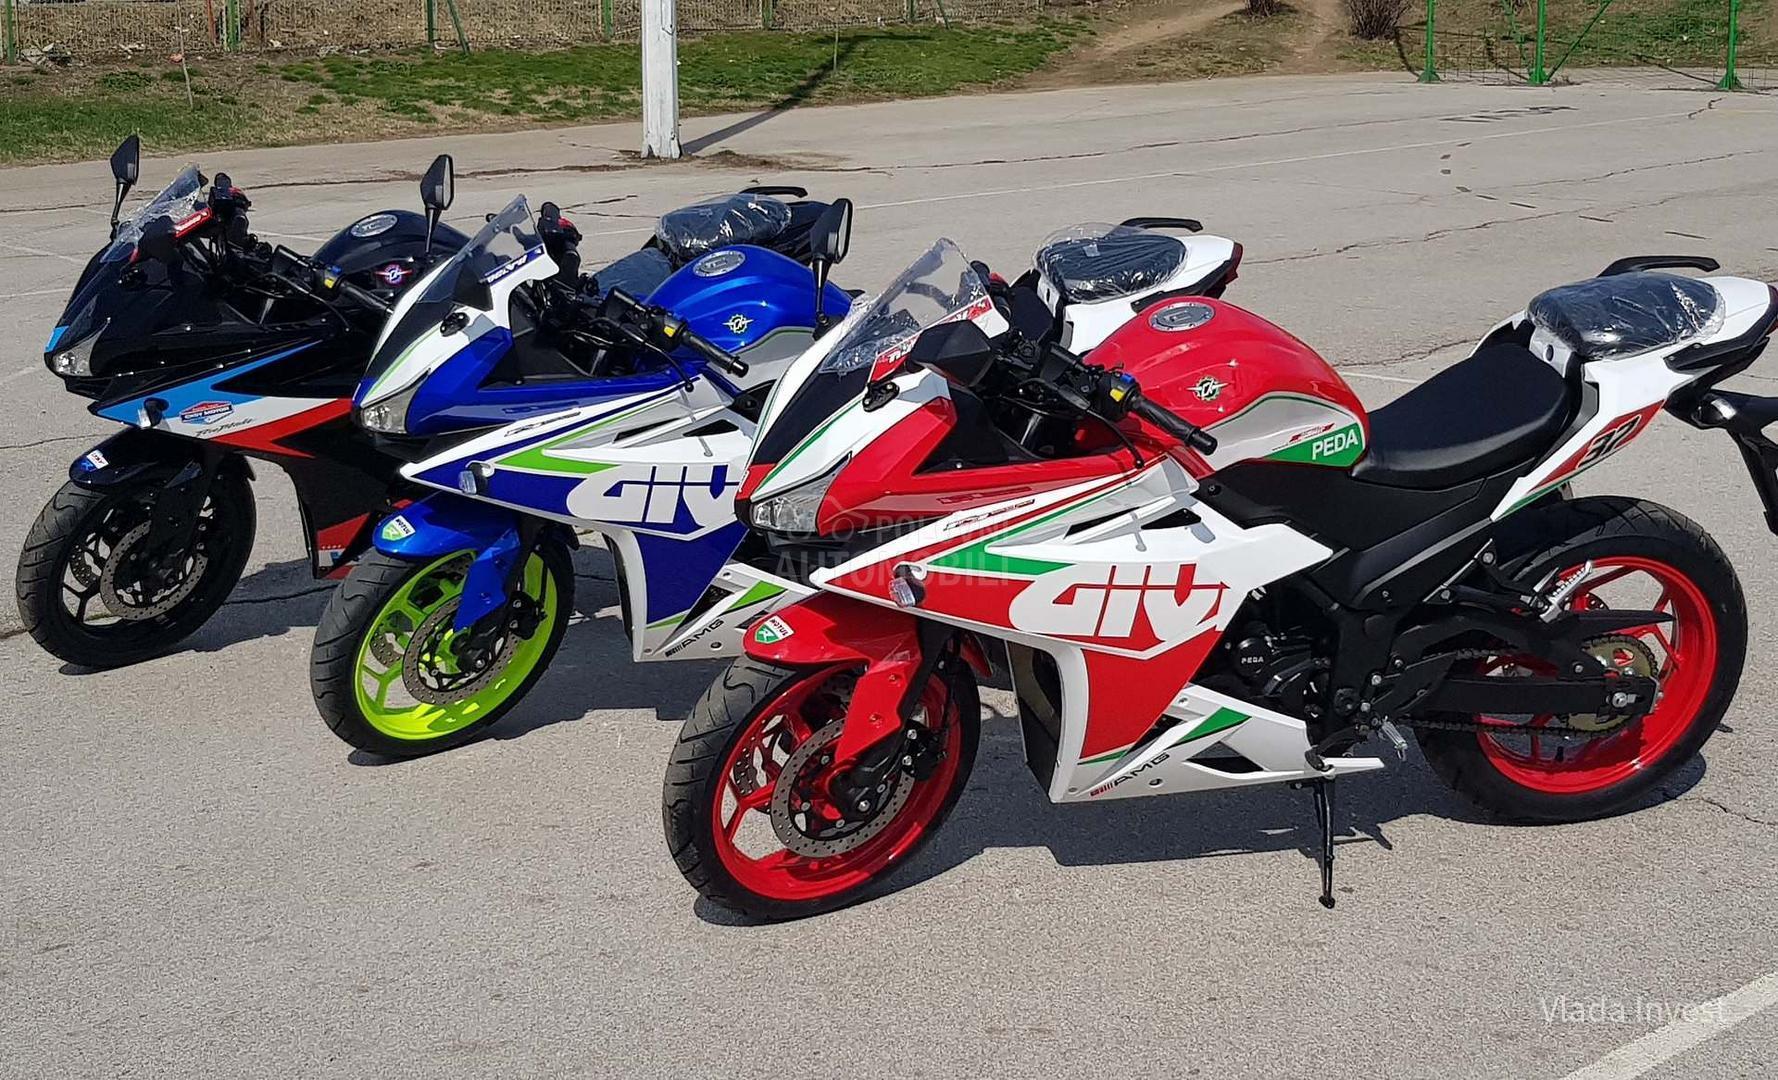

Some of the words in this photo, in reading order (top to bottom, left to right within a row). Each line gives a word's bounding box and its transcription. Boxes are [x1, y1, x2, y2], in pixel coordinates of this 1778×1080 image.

[1312, 429, 1359, 461] PEDA
[682, 618, 725, 648] AMG
[770, 618, 789, 636] MOTUL
[1114, 752, 1170, 786] AMG
